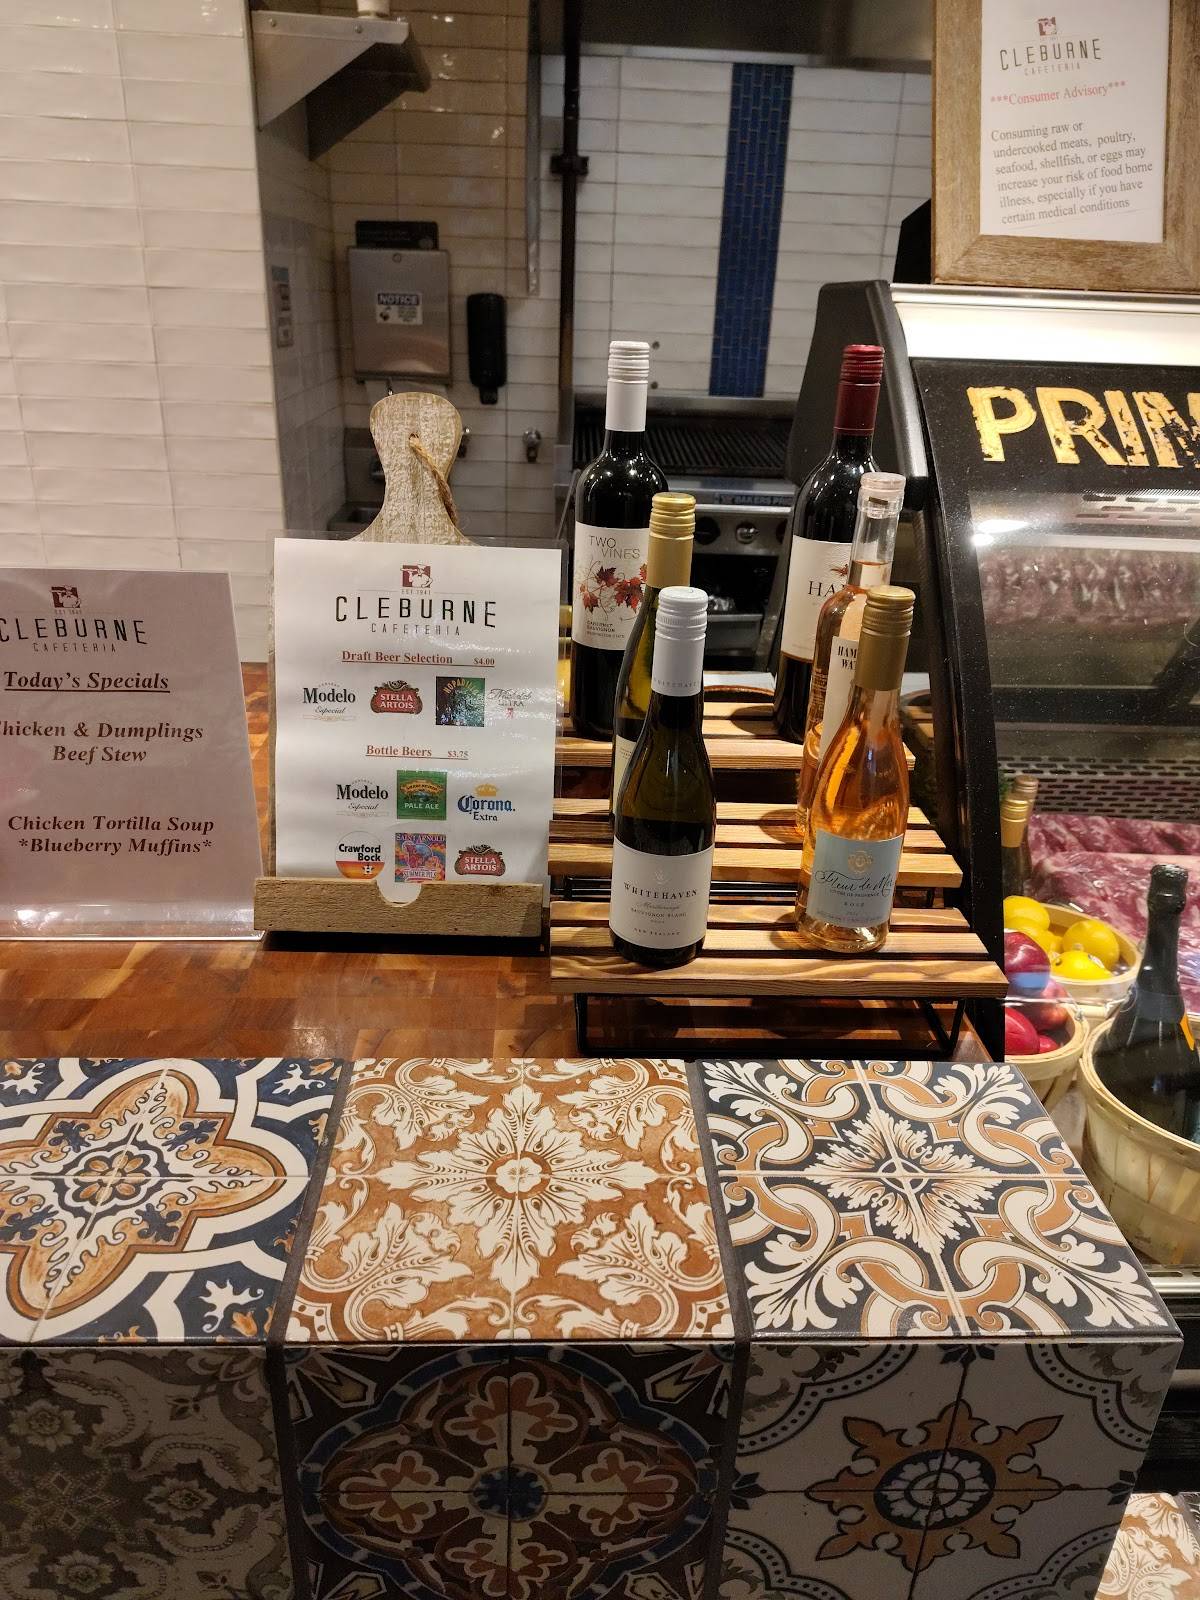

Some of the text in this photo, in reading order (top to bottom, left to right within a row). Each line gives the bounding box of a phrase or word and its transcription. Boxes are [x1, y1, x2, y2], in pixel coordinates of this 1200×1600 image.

[999, 38, 1102, 71] CLEBURNE
[991, 121, 1083, 142] Consuming raw or
[993, 130, 1136, 159] undercooked meats, poultry,
[995, 147, 1146, 175] seafood, shellfish, or eggs may
[998, 161, 1153, 192] increase your risk of food borne
[1000, 179, 1143, 208] illness, especially if you have
[1001, 198, 1130, 224] certain medical conditions
[380, 294, 418, 305] NOTICE
[589, 535, 616, 549] TWO
[601, 548, 640, 560] VINES
[807, 580, 846, 597] HA
[336, 596, 496, 628] CLEBURNE
[0, 617, 148, 645] CLEBURNE
[371, 622, 460, 636] CAFETERIA
[33, 642, 116, 653] CAFETERIA
[342, 651, 495, 666] Draft Beer Selection $4.00
[4, 670, 169, 691] Today's Specials
[303, 687, 356, 704] Modelo
[380, 693, 413, 701] STELLA
[380, 701, 415, 709] ARTOIS
[0, 720, 203, 742] hicken & Dumplings
[53, 745, 147, 765] Beef Stew
[366, 745, 469, 759] Bottle Beers $3.75
[336, 784, 388, 800] Modelo
[8, 815, 215, 834] Chicken Tortilla Soup
[473, 812, 498, 821] Extra
[338, 843, 381, 853] Crawford
[357, 852, 381, 862] Bock
[464, 864, 498, 872] ARTOIS
[623, 882, 698, 900] WHITEHAVEN
